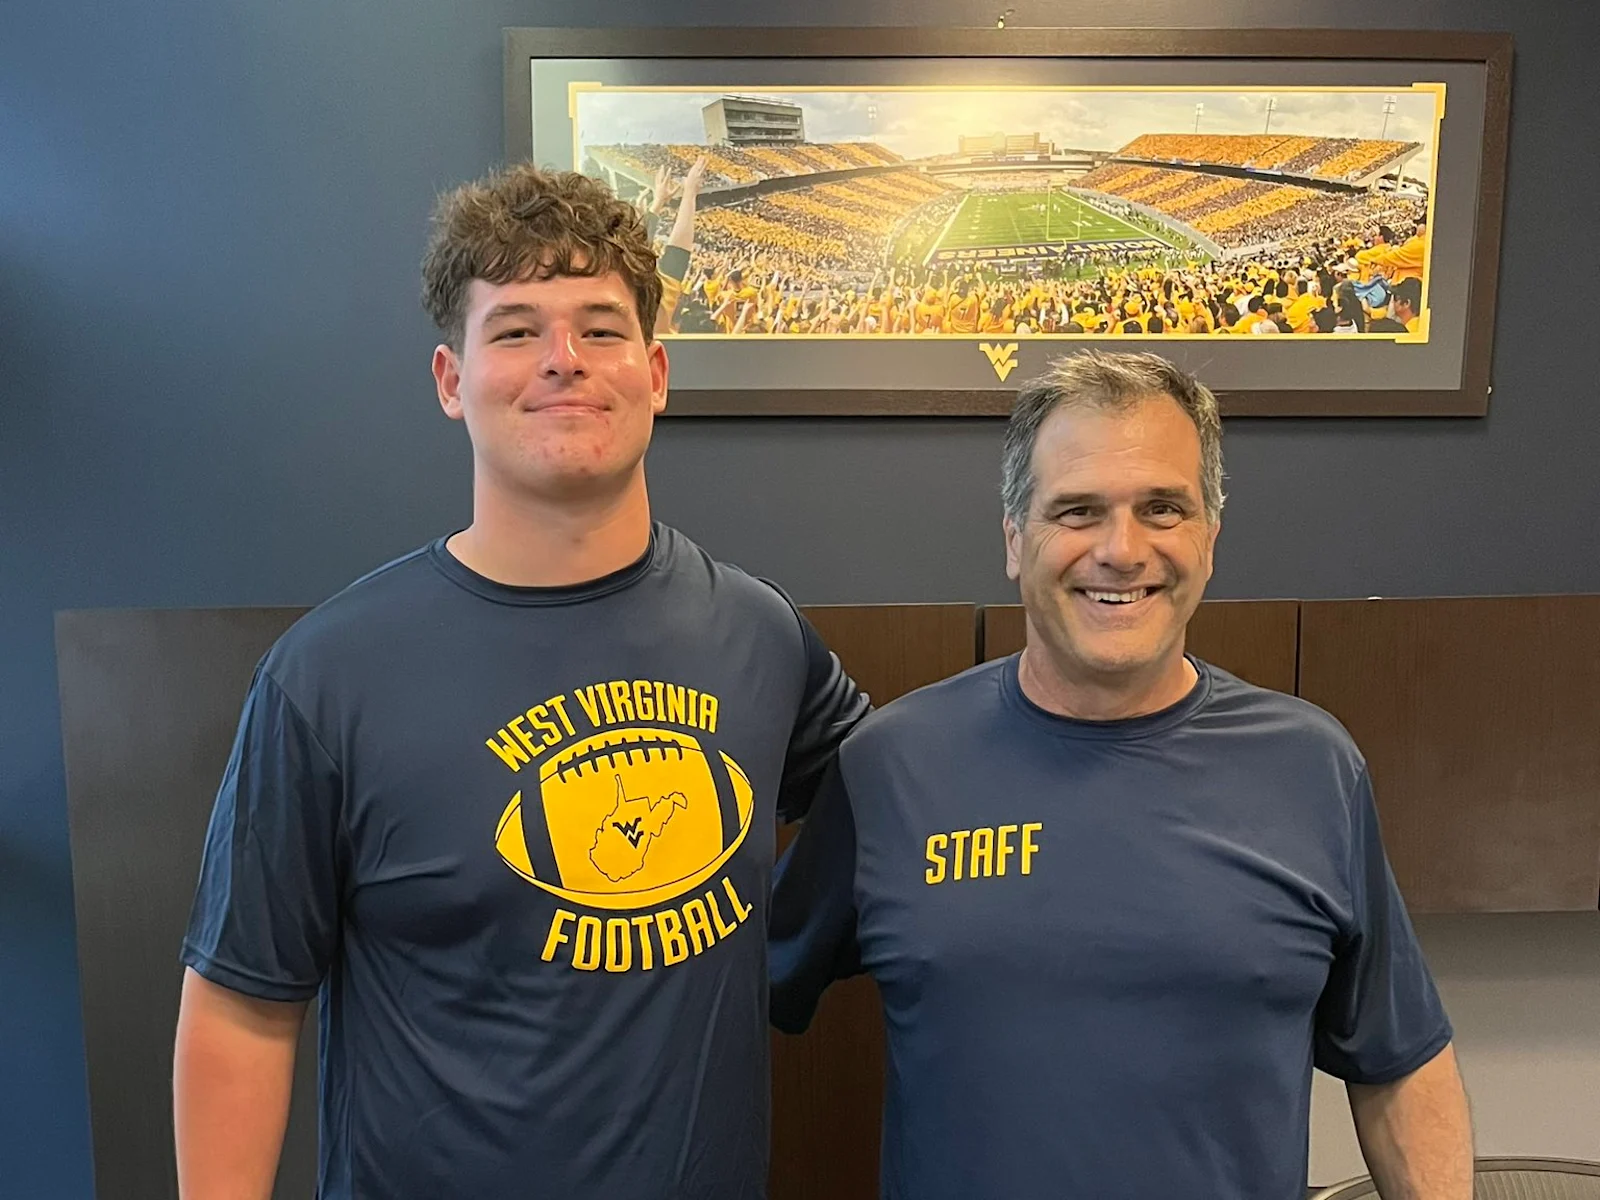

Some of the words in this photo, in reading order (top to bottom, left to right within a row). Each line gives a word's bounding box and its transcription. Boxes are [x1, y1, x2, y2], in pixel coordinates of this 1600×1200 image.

[485, 694, 577, 773] WEST
[573, 679, 719, 734] VIRGINIA
[925, 822, 1043, 885] STAFF
[540, 876, 753, 973] FOOTBALL
